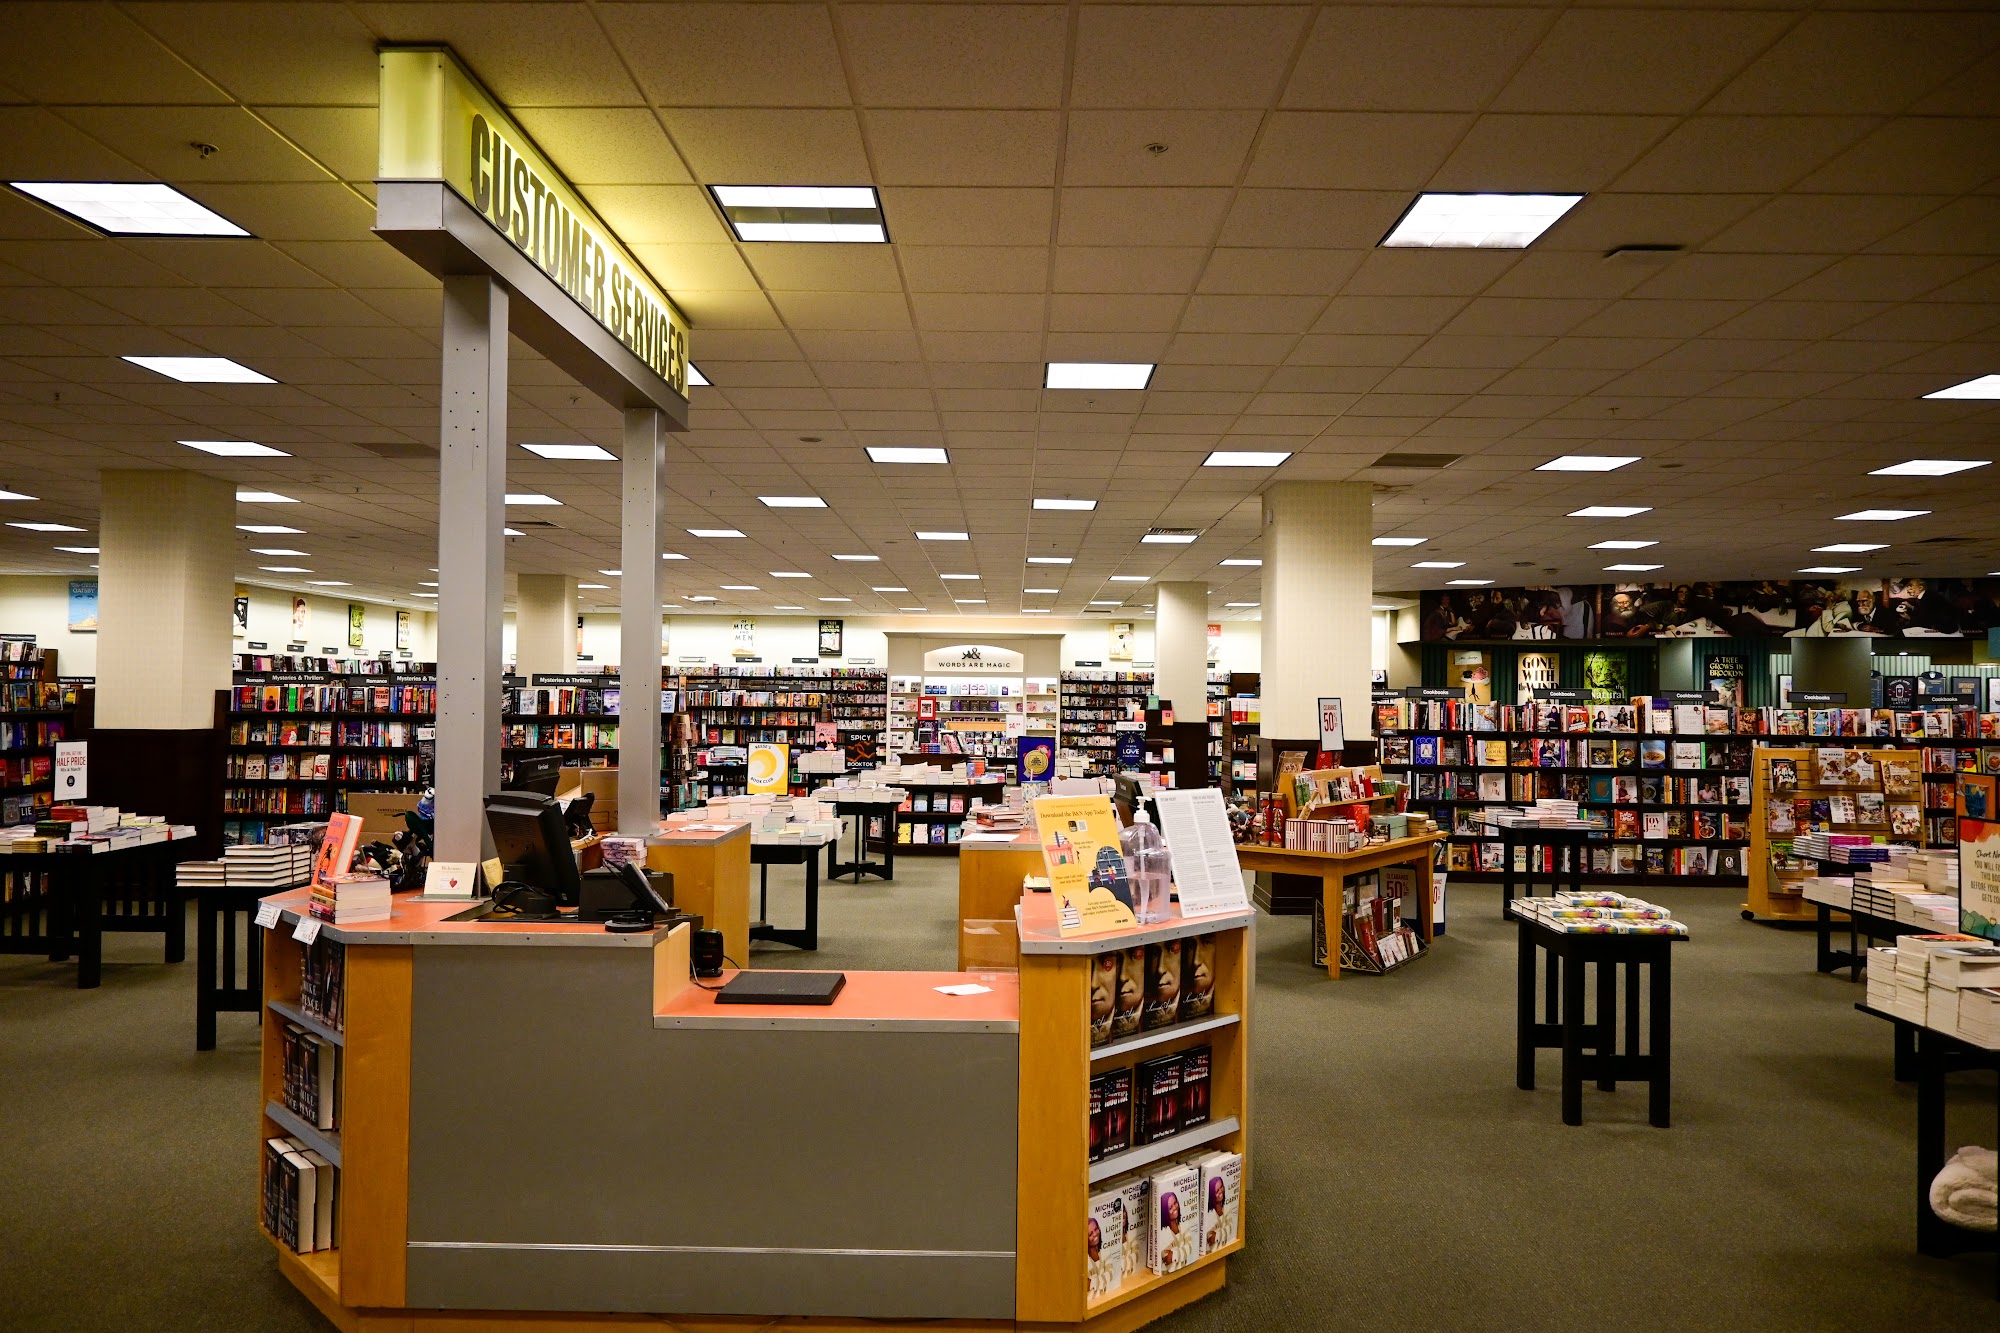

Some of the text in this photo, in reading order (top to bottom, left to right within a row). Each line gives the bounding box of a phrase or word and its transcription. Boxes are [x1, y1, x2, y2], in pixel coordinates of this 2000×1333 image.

[471, 114, 684, 395] CUSTOMER SERVICES
[1523, 657, 1554, 669] GONE
[1522, 670, 1554, 681] WITH
[57, 756, 86, 766] HALF PRICE
[21, 806, 32, 816] LIE
[1645, 814, 1660, 832] joy
[1976, 850, 1992, 858] Short
[1984, 862, 1994, 870] WILL
[1981, 872, 1990, 880] THIS
[1971, 881, 1999, 893] BEFORE YOUR
[1982, 894, 1992, 902] GETS
[300, 1102, 316, 1122] PENCE
[1174, 1173, 1198, 1187] MICHELLE
[1180, 1183, 1198, 1193] OBAMA
[1228, 1181, 1240, 1191] LIGHT
[1184, 1196, 1198, 1207] LIGHT
[1226, 1195, 1239, 1205] CARRY
[1095, 1202, 1114, 1213] MICHE
[1182, 1213, 1198, 1223] CARRY
[1106, 1224, 1121, 1233] LIGHT
[1130, 1221, 1146, 1231] CARRY
[1103, 1239, 1120, 1250] CARRY
